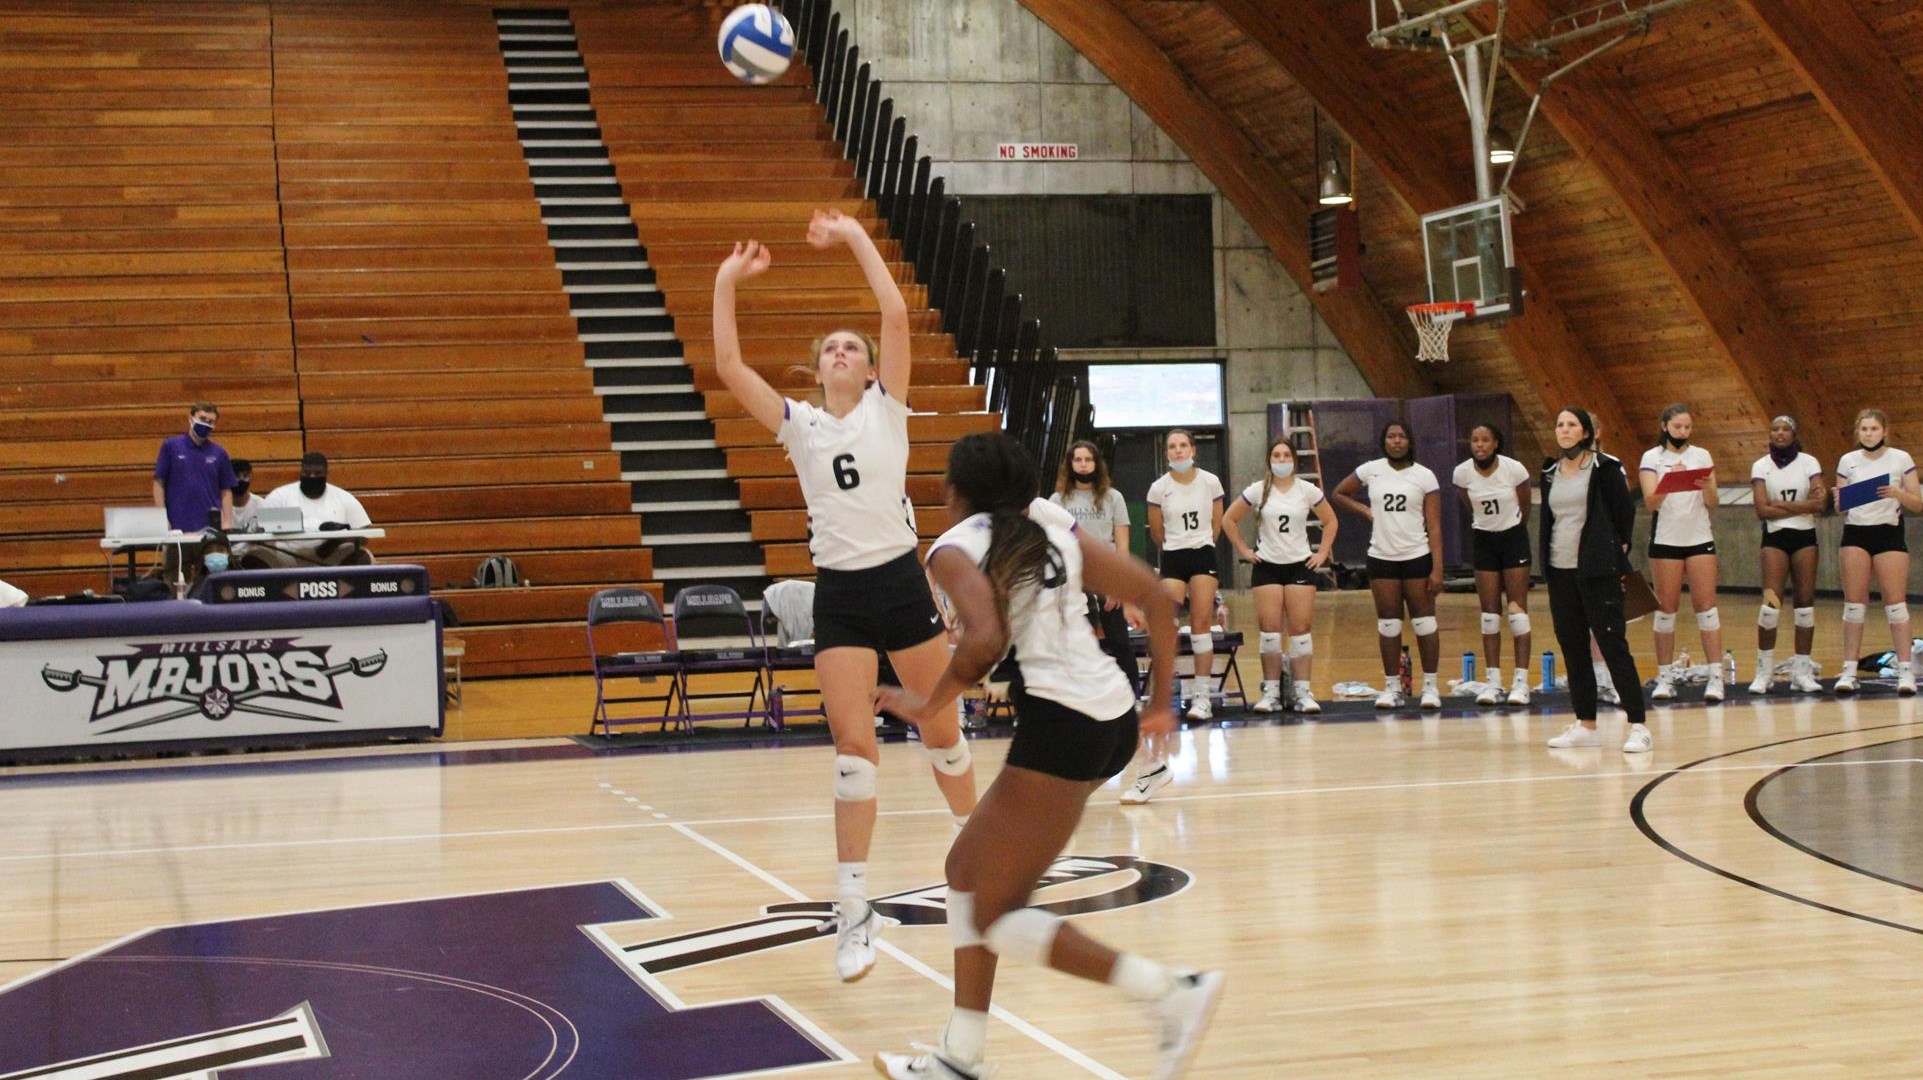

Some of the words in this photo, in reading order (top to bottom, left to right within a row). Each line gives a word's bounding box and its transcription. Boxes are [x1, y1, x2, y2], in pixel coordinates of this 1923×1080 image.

[999, 145, 1016, 159] NO
[1022, 145, 1077, 159] SMOKING
[832, 452, 861, 491] 6
[1383, 493, 1408, 512] 22
[1780, 488, 1798, 501] 17
[1480, 498, 1501, 516] 21
[1181, 510, 1200, 532] 13
[1278, 514, 1290, 533] 2
[237, 586, 266, 598] BONUS
[299, 580, 338, 599] POSS
[369, 581, 398, 593] BONUS
[159, 639, 274, 655] MILLSAPS
[95, 650, 334, 717] MAJORS
